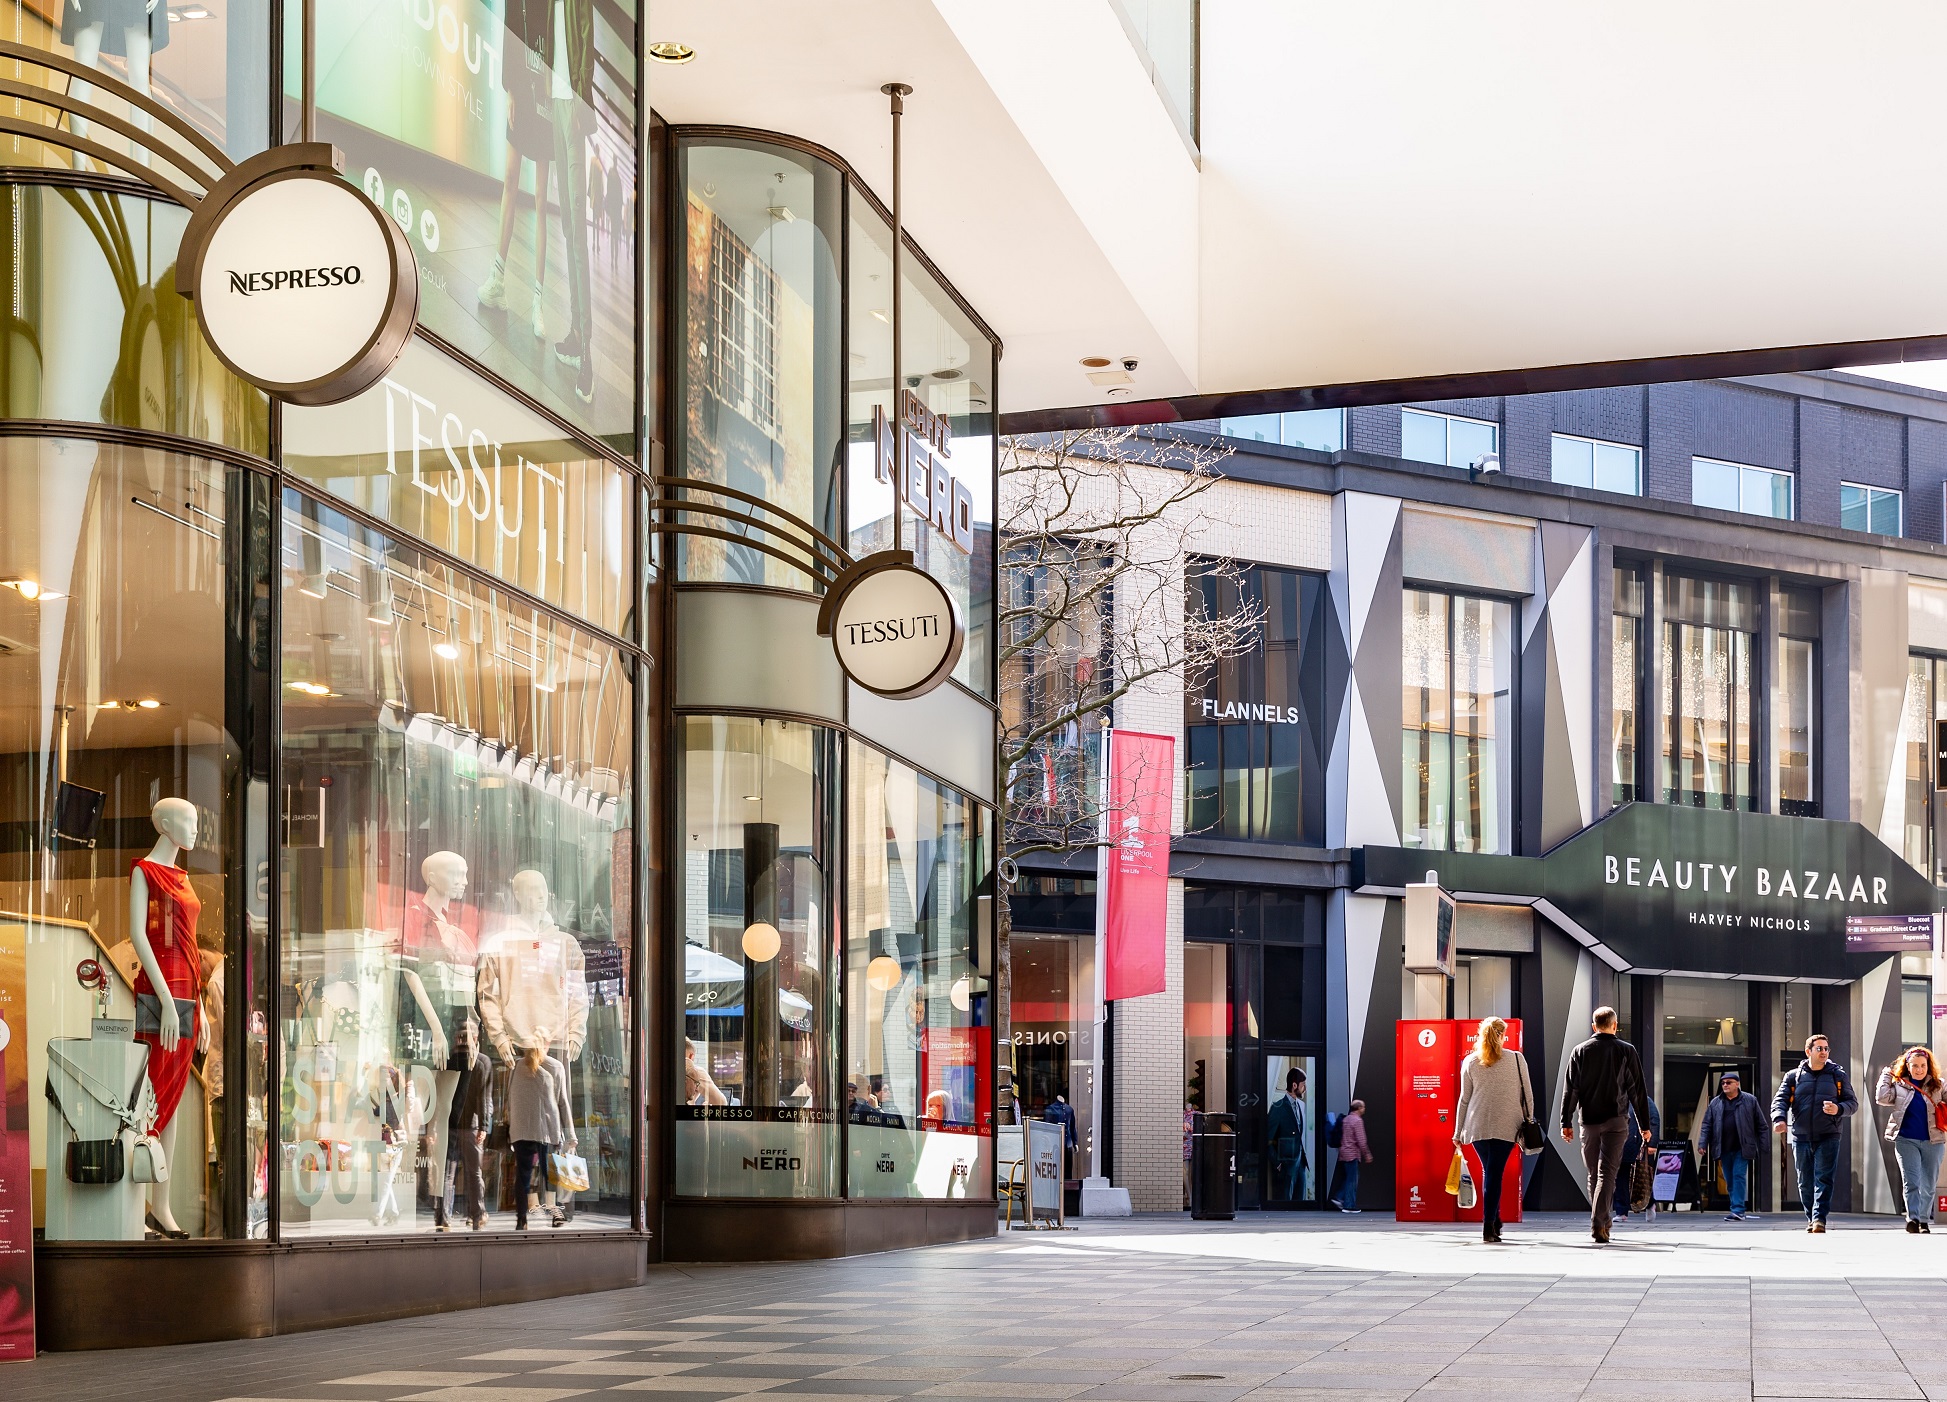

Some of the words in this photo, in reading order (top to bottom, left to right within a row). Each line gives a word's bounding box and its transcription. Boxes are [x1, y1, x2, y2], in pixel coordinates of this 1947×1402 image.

[412, 46, 446, 88] OWN
[448, 75, 484, 122] STYLE
[224, 265, 362, 297] NESPRESSO
[419, 266, 448, 294] .co.uk
[381, 377, 565, 565] TESSUTI
[874, 404, 974, 555] NERO
[844, 614, 939, 646] TESSUTI
[1202, 698, 1299, 725] FLANNELS
[1120, 849, 1153, 859] LIVERPOOL
[1604, 855, 1738, 893] BEAUTY
[1757, 867, 1888, 905] BAZAAR
[1689, 912, 1743, 927] HARVEY
[1750, 916, 1811, 932] NICHOLS
[95, 1025, 129, 1033] VALENTINO
[291, 1056, 437, 1126] STAND
[693, 1108, 753, 1119] ESPRESSO
[778, 1109, 835, 1121] CAPPUCCINO
[291, 1139, 387, 1207] OUT
[742, 1156, 802, 1171] NERO
[876, 1160, 895, 1173] NERO
[952, 1164, 968, 1176] NERO
[1034, 1161, 1058, 1180] NERO
[392, 1172, 414, 1184] STYLE
